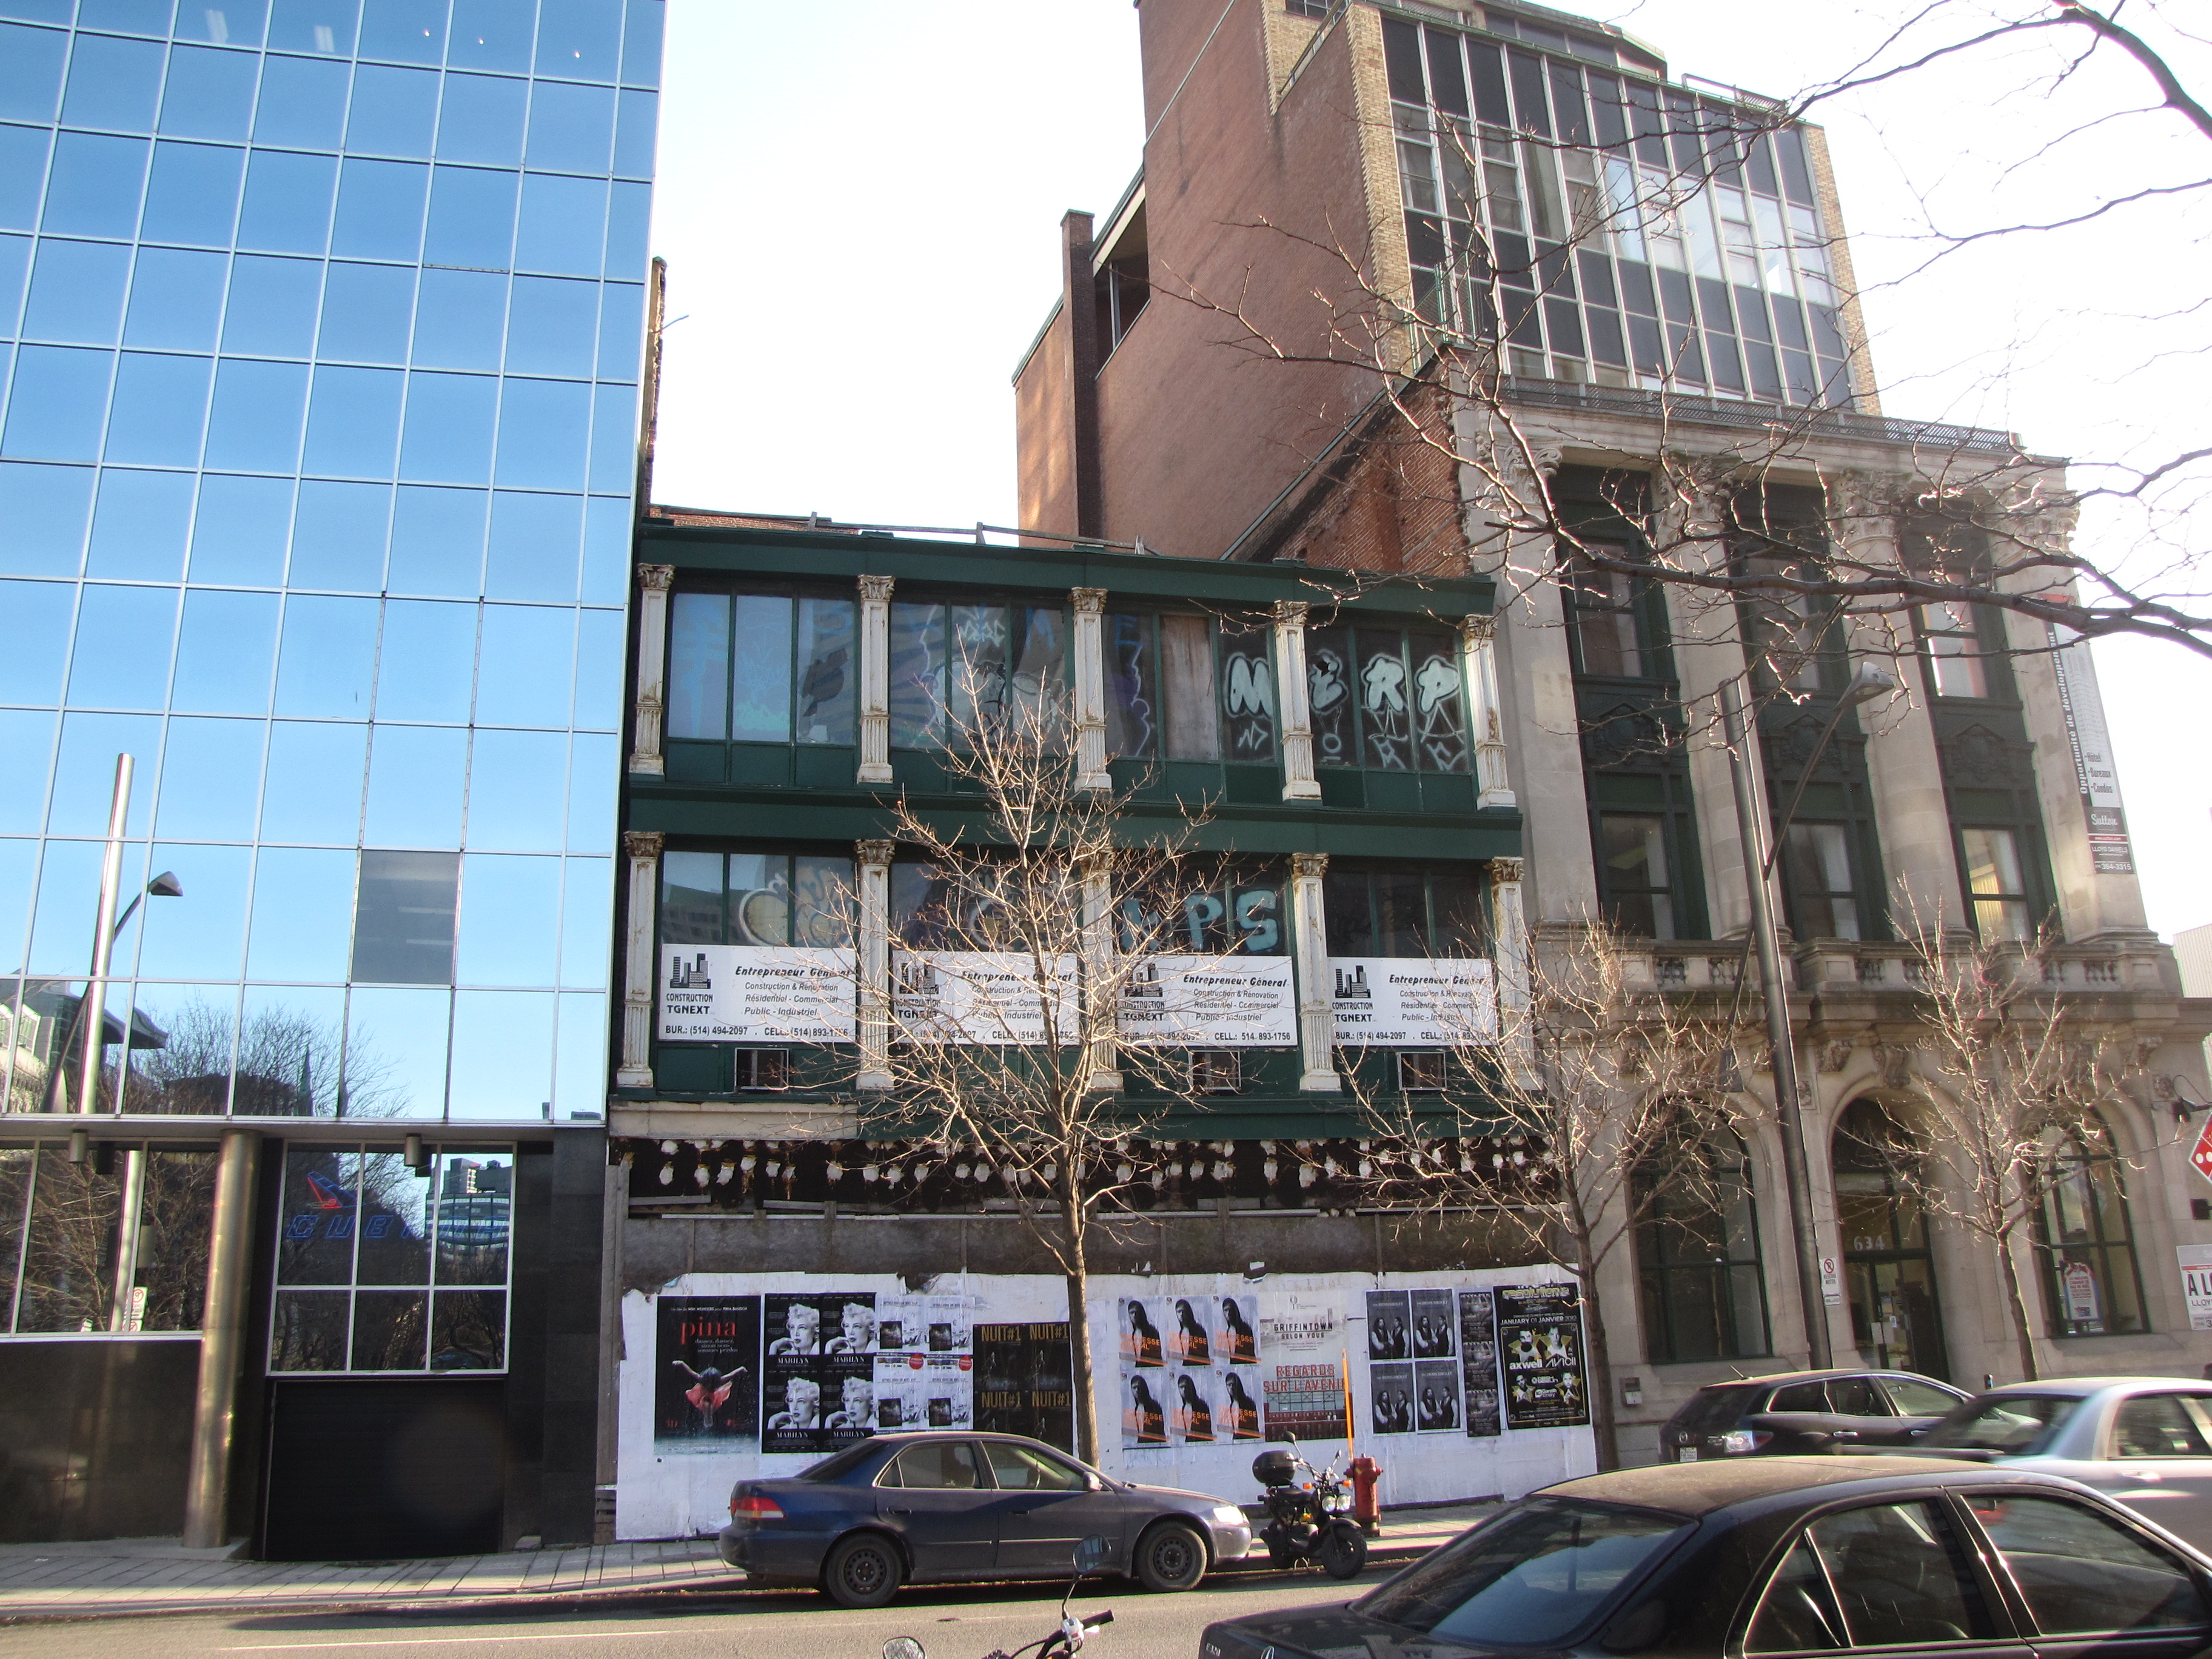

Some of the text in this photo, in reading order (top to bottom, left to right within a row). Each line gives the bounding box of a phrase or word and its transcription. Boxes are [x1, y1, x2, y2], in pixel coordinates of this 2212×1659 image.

[2066, 714, 2074, 728] de
[2090, 767, 2111, 778] Bureaux
[2093, 782, 2113, 794] Condos
[2090, 813, 2118, 826] Sutton
[736, 965, 805, 978] Entrepreneur
[1183, 974, 1247, 987] Entrepreneur
[745, 982, 790, 991] Construction
[666, 993, 714, 1003] CONSTRUCTION
[745, 993, 788, 1003] Résidentiel
[1193, 988, 1236, 997] Construction
[1242, 990, 1279, 999] Rénovation
[667, 1005, 710, 1015] TGNEXT
[744, 1007, 817, 1016] Public Industriel
[1332, 1002, 1373, 1010] CONSTRUCTION
[1004, 1011, 1042, 1020] Industriel
[1335, 1014, 1373, 1022] TGNEXT
[665, 1025, 688, 1035] BUR.:
[689, 1025, 710, 1036] (514)
[712, 1026, 748, 1036] 494-2097
[791, 1027, 811, 1037] (514)
[1019, 1031, 1037, 1041] (514)
[1258, 1032, 1291, 1041] 893-1756
[1335, 1031, 1355, 1040] BUR.:
[1375, 1031, 1407, 1041] 494-2097
[1853, 1235, 1885, 1252] 634
[2187, 1270, 2199, 1296] À
[680, 1316, 737, 1345] pina
[1029, 1323, 1069, 1340] NUIT#1
[1274, 1322, 1333, 1332] GRIFFINTOWN
[981, 1326, 1022, 1342] NUIT#1
[1509, 1359, 1543, 1370] axwell
[1276, 1364, 1335, 1378] REGARDS
[1263, 1379, 1288, 1393] SUR
[982, 1390, 1022, 1409] NUIT#1
[1032, 1390, 1071, 1407] NUIT#1
